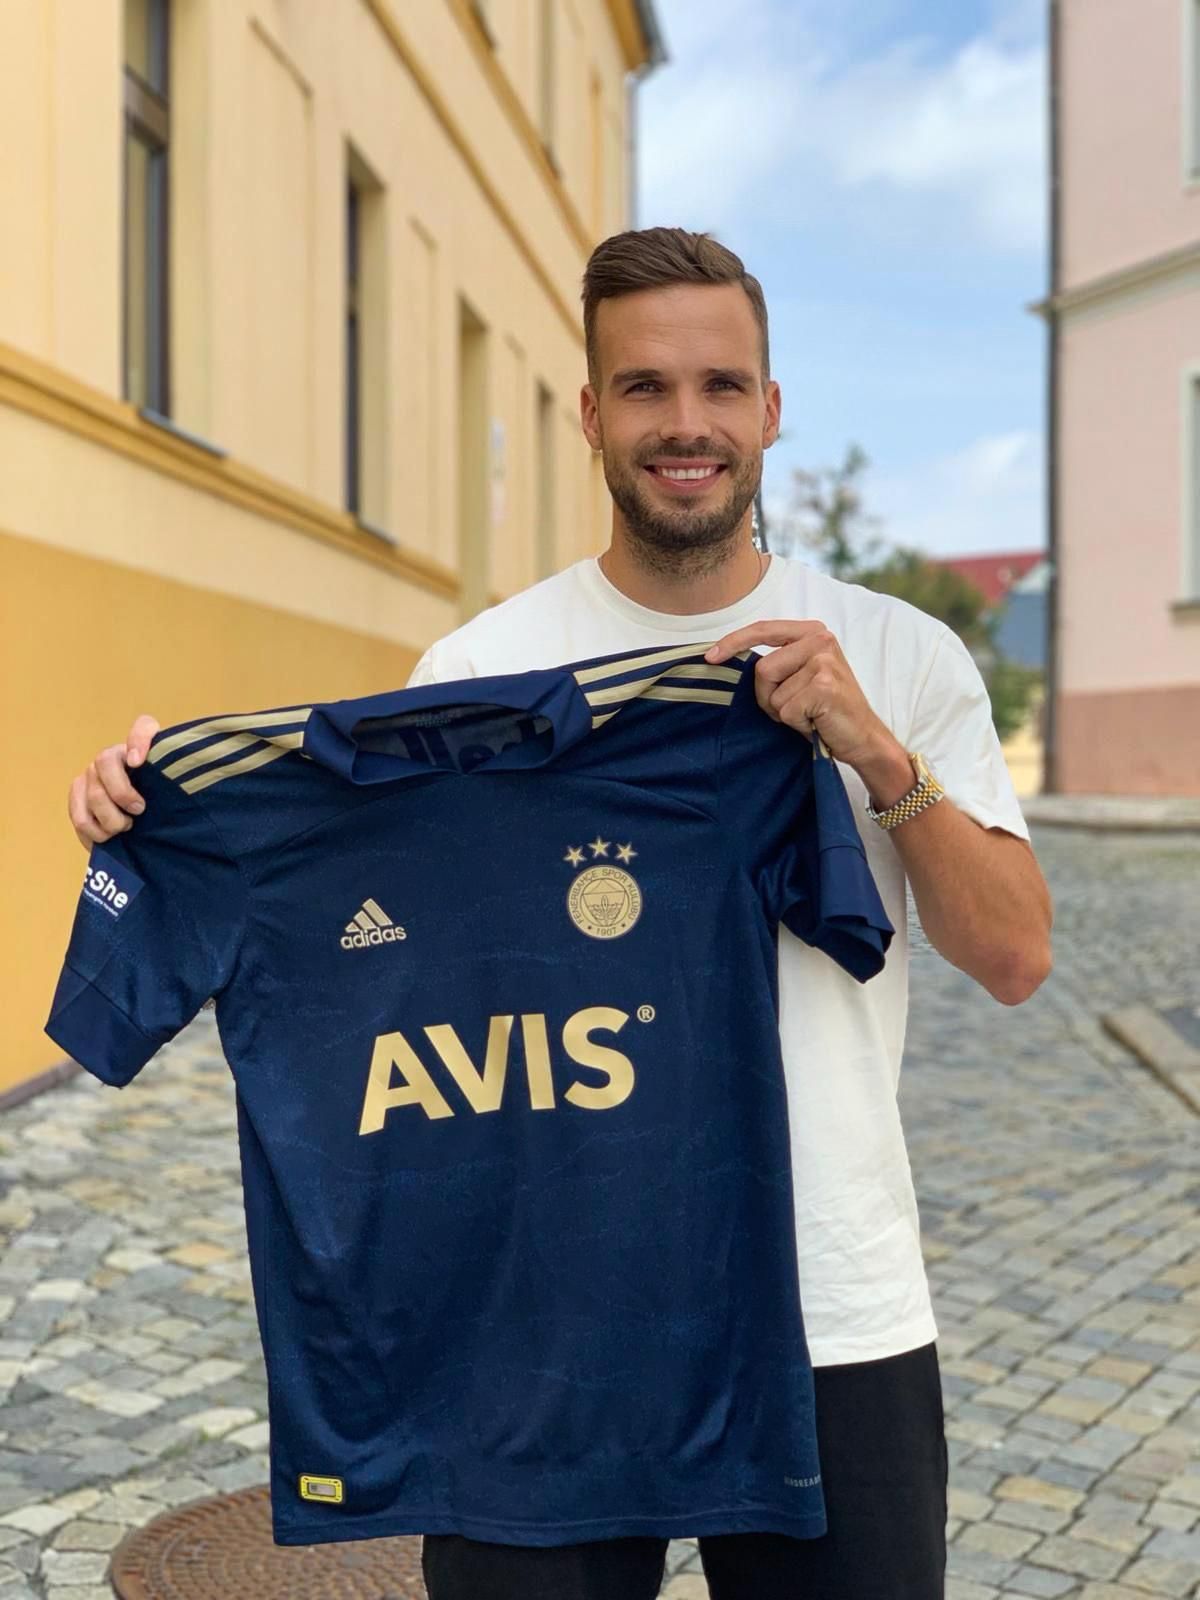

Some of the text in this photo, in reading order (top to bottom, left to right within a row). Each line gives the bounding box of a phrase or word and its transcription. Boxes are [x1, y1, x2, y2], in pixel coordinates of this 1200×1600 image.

[601, 868, 628, 883] SPOR
[340, 926, 407, 949] adidas
[596, 926, 617, 937] 1907
